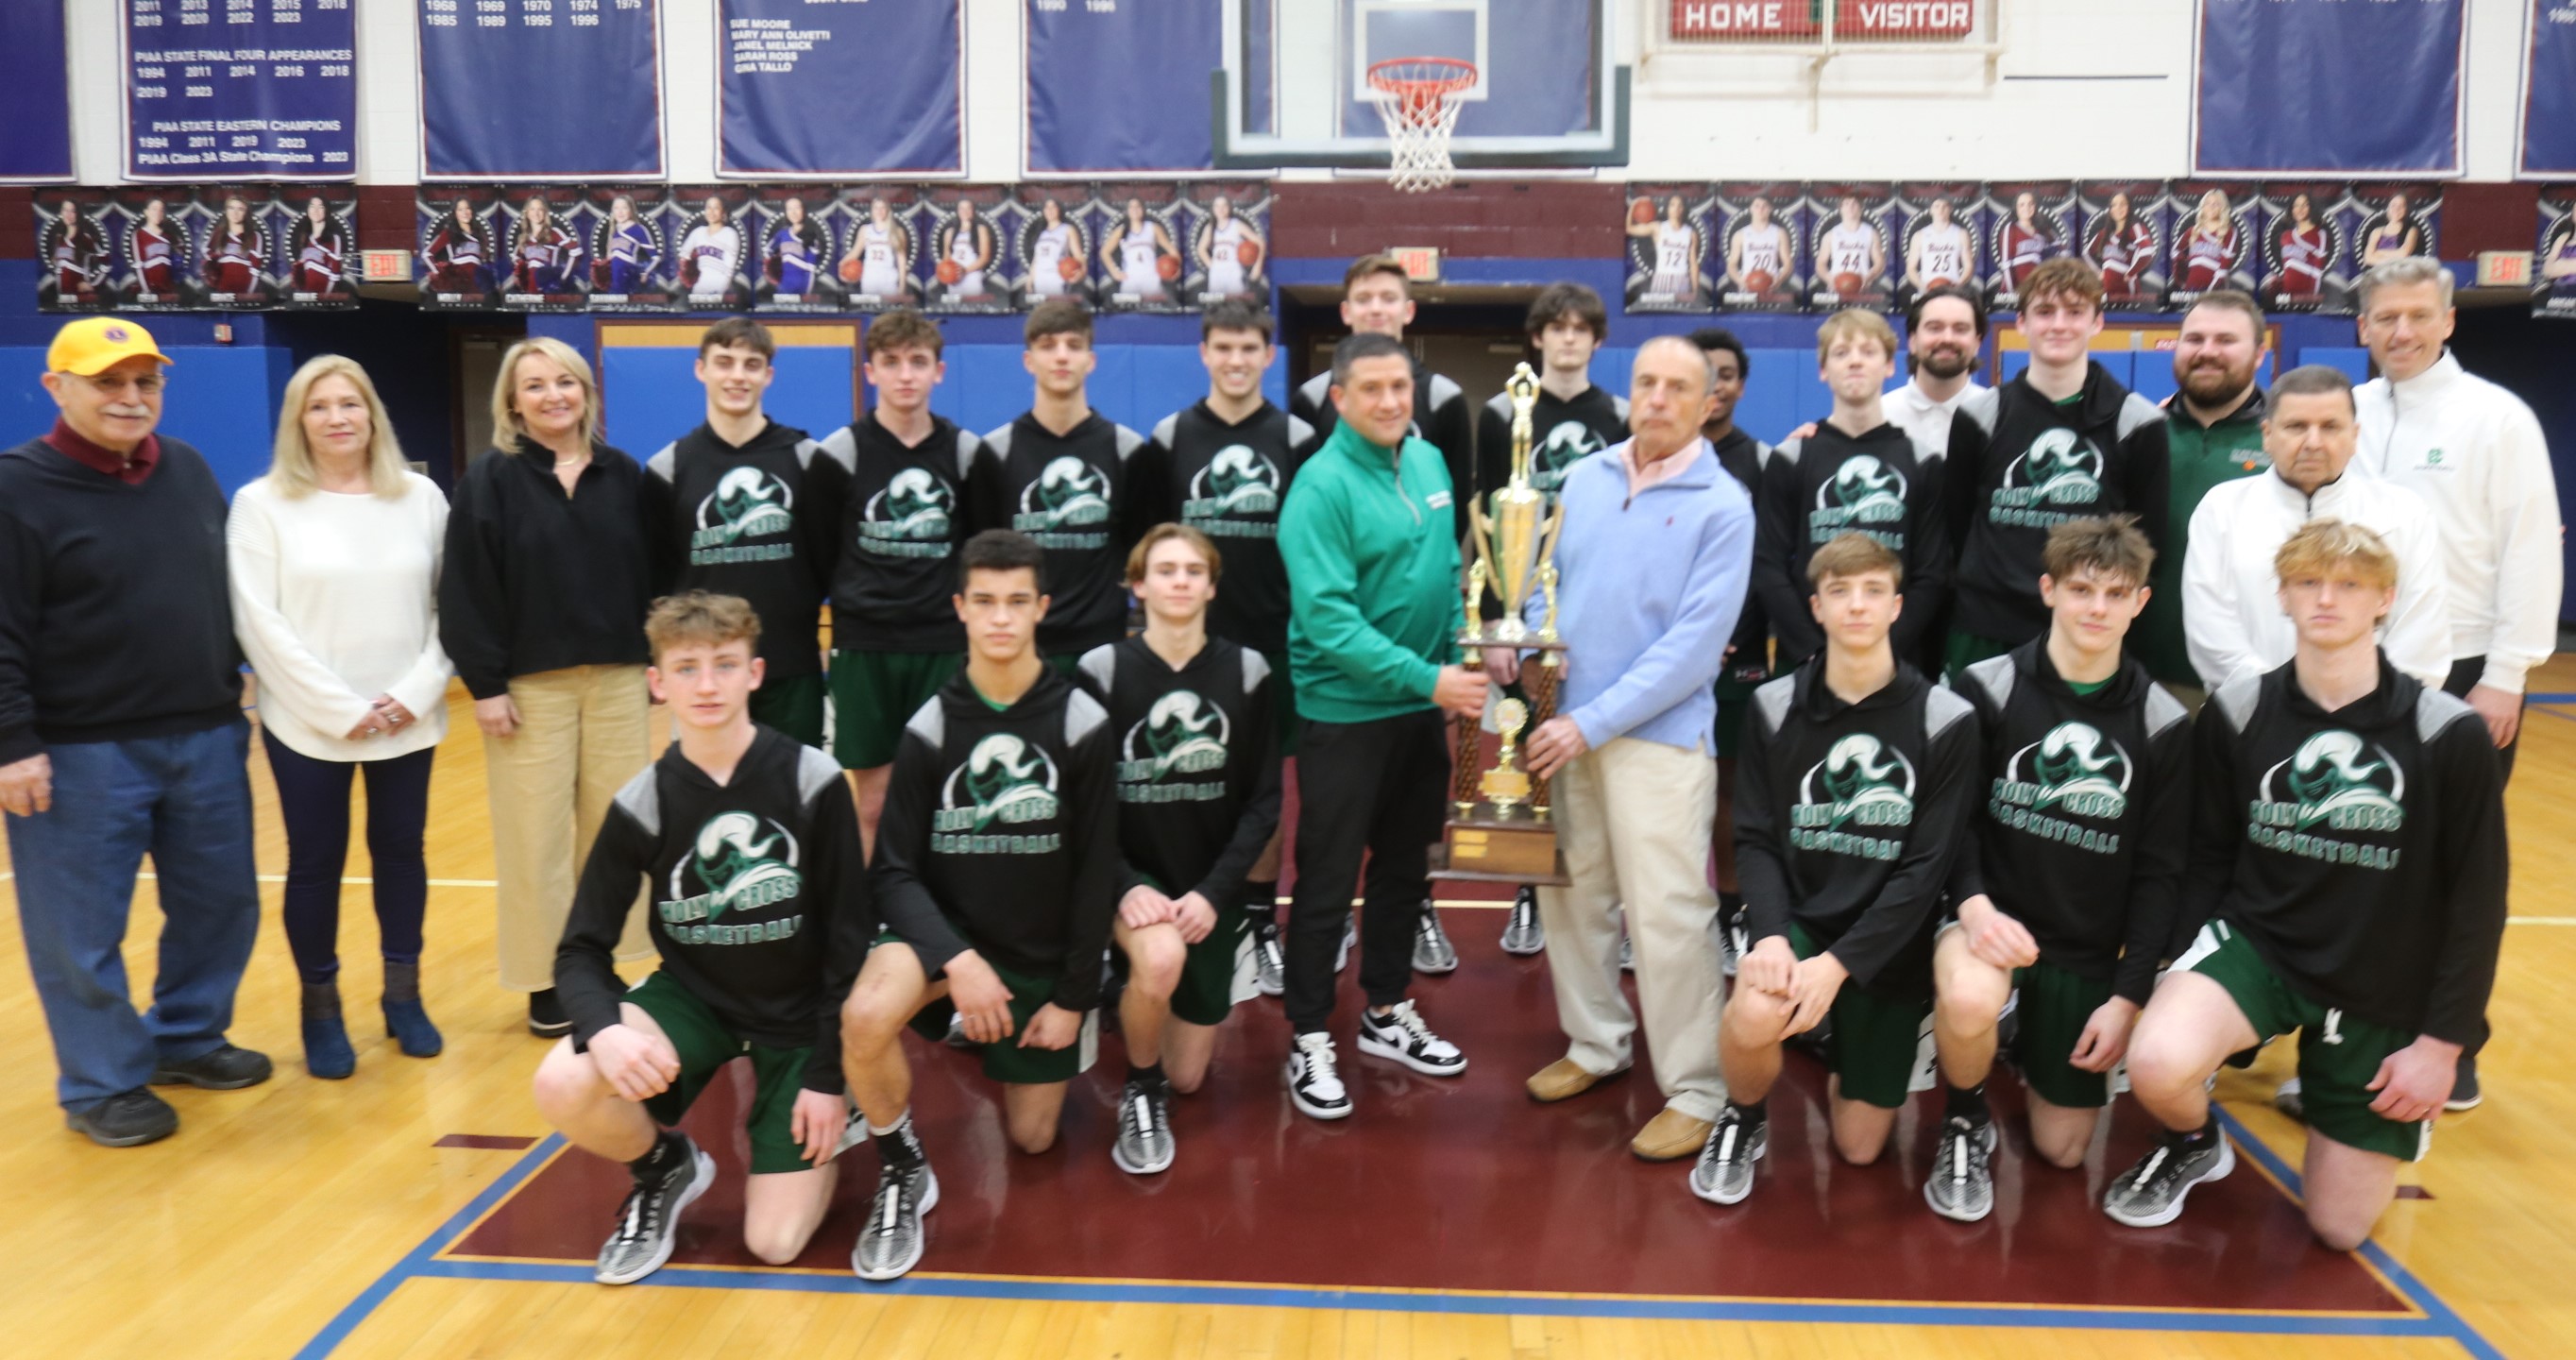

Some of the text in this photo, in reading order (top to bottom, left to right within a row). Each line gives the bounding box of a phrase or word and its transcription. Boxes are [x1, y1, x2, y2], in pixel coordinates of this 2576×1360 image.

[427, 0, 457, 11] 1968
[477, 1, 506, 11] 1969
[523, 0, 551, 10] 1970
[570, 0, 599, 10] 1974
[1686, 4, 1782, 28] HOME
[1860, 3, 1970, 28] VISITOR
[427, 14, 599, 26] 1985 1989 1995 1996
[731, 19, 790, 29] SUE MOORE
[732, 31, 830, 40] MARY ANN OLIVETTI
[735, 41, 813, 51] JANEL MELNICK
[135, 50, 352, 62] PIAA STATE FINAL FOUR APPEARANCES
[735, 52, 798, 62] SARAH ROSS
[758, 62, 791, 72] TALLO
[185, 66, 212, 77] 2011
[152, 120, 341, 132] PIAA STATE EASTERN CHAMPIONS
[138, 154, 168, 164] PIAA
[170, 153, 201, 164] Class
[202, 153, 218, 162] 3A
[219, 151, 248, 162] State
[248, 150, 314, 164] Champions
[2490, 256, 2524, 281] EXIT
[1991, 482, 2098, 507] HOLY CROSS
[1175, 749, 1226, 773] CROSS
[1991, 777, 2125, 820] HOLY CROSS
[934, 795, 1058, 831] HOLY CROSS
[1791, 800, 1912, 827] HOLY CROSS
[2250, 800, 2402, 832] HOLY CROSS
[1989, 797, 2120, 854] BASKETBALL
[931, 832, 1060, 854] BASKETBALL
[658, 875, 801, 924] HOLY CROSS
